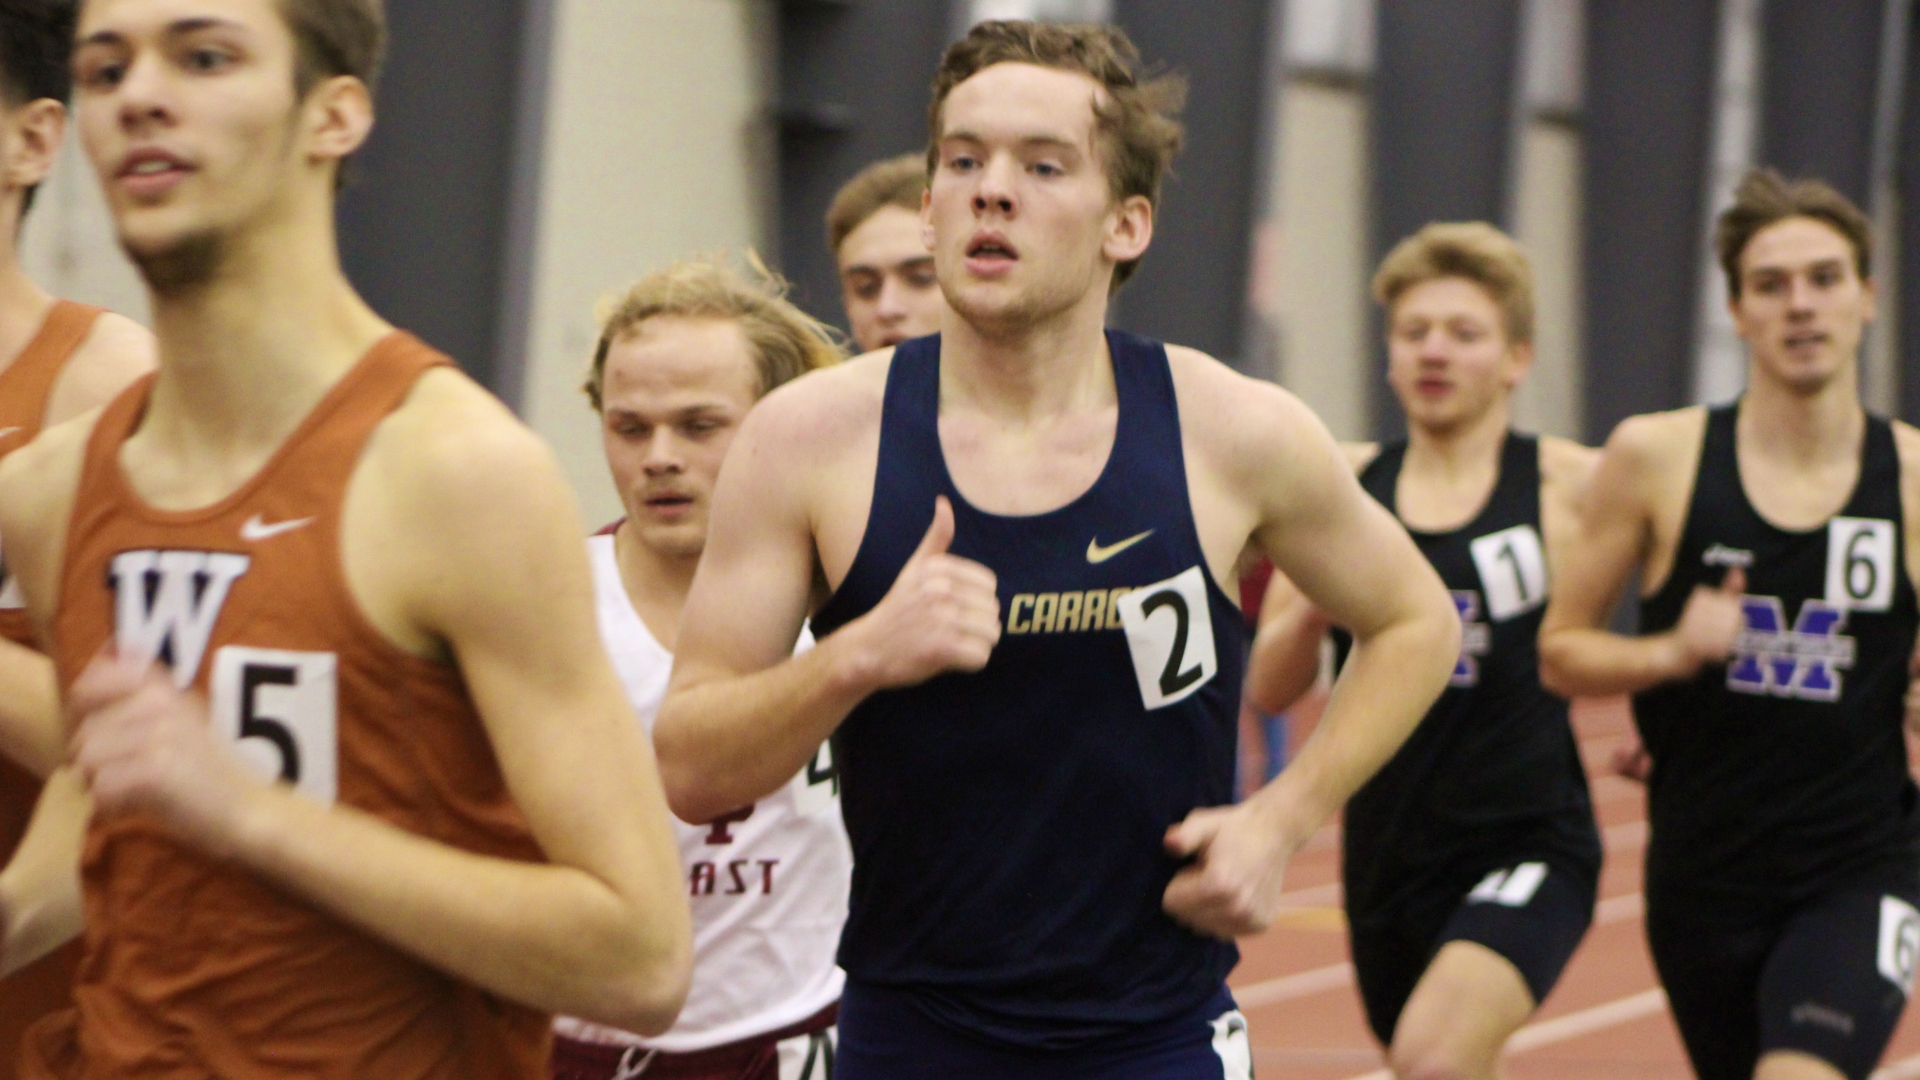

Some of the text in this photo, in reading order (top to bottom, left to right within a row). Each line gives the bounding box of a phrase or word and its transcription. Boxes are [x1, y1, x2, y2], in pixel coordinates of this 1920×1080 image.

[1497, 541, 1528, 602] 1
[1844, 529, 1877, 600] 6
[106, 549, 251, 692] W
[1141, 588, 1203, 697] 2
[1726, 594, 1848, 702] M
[238, 663, 301, 785] 5
